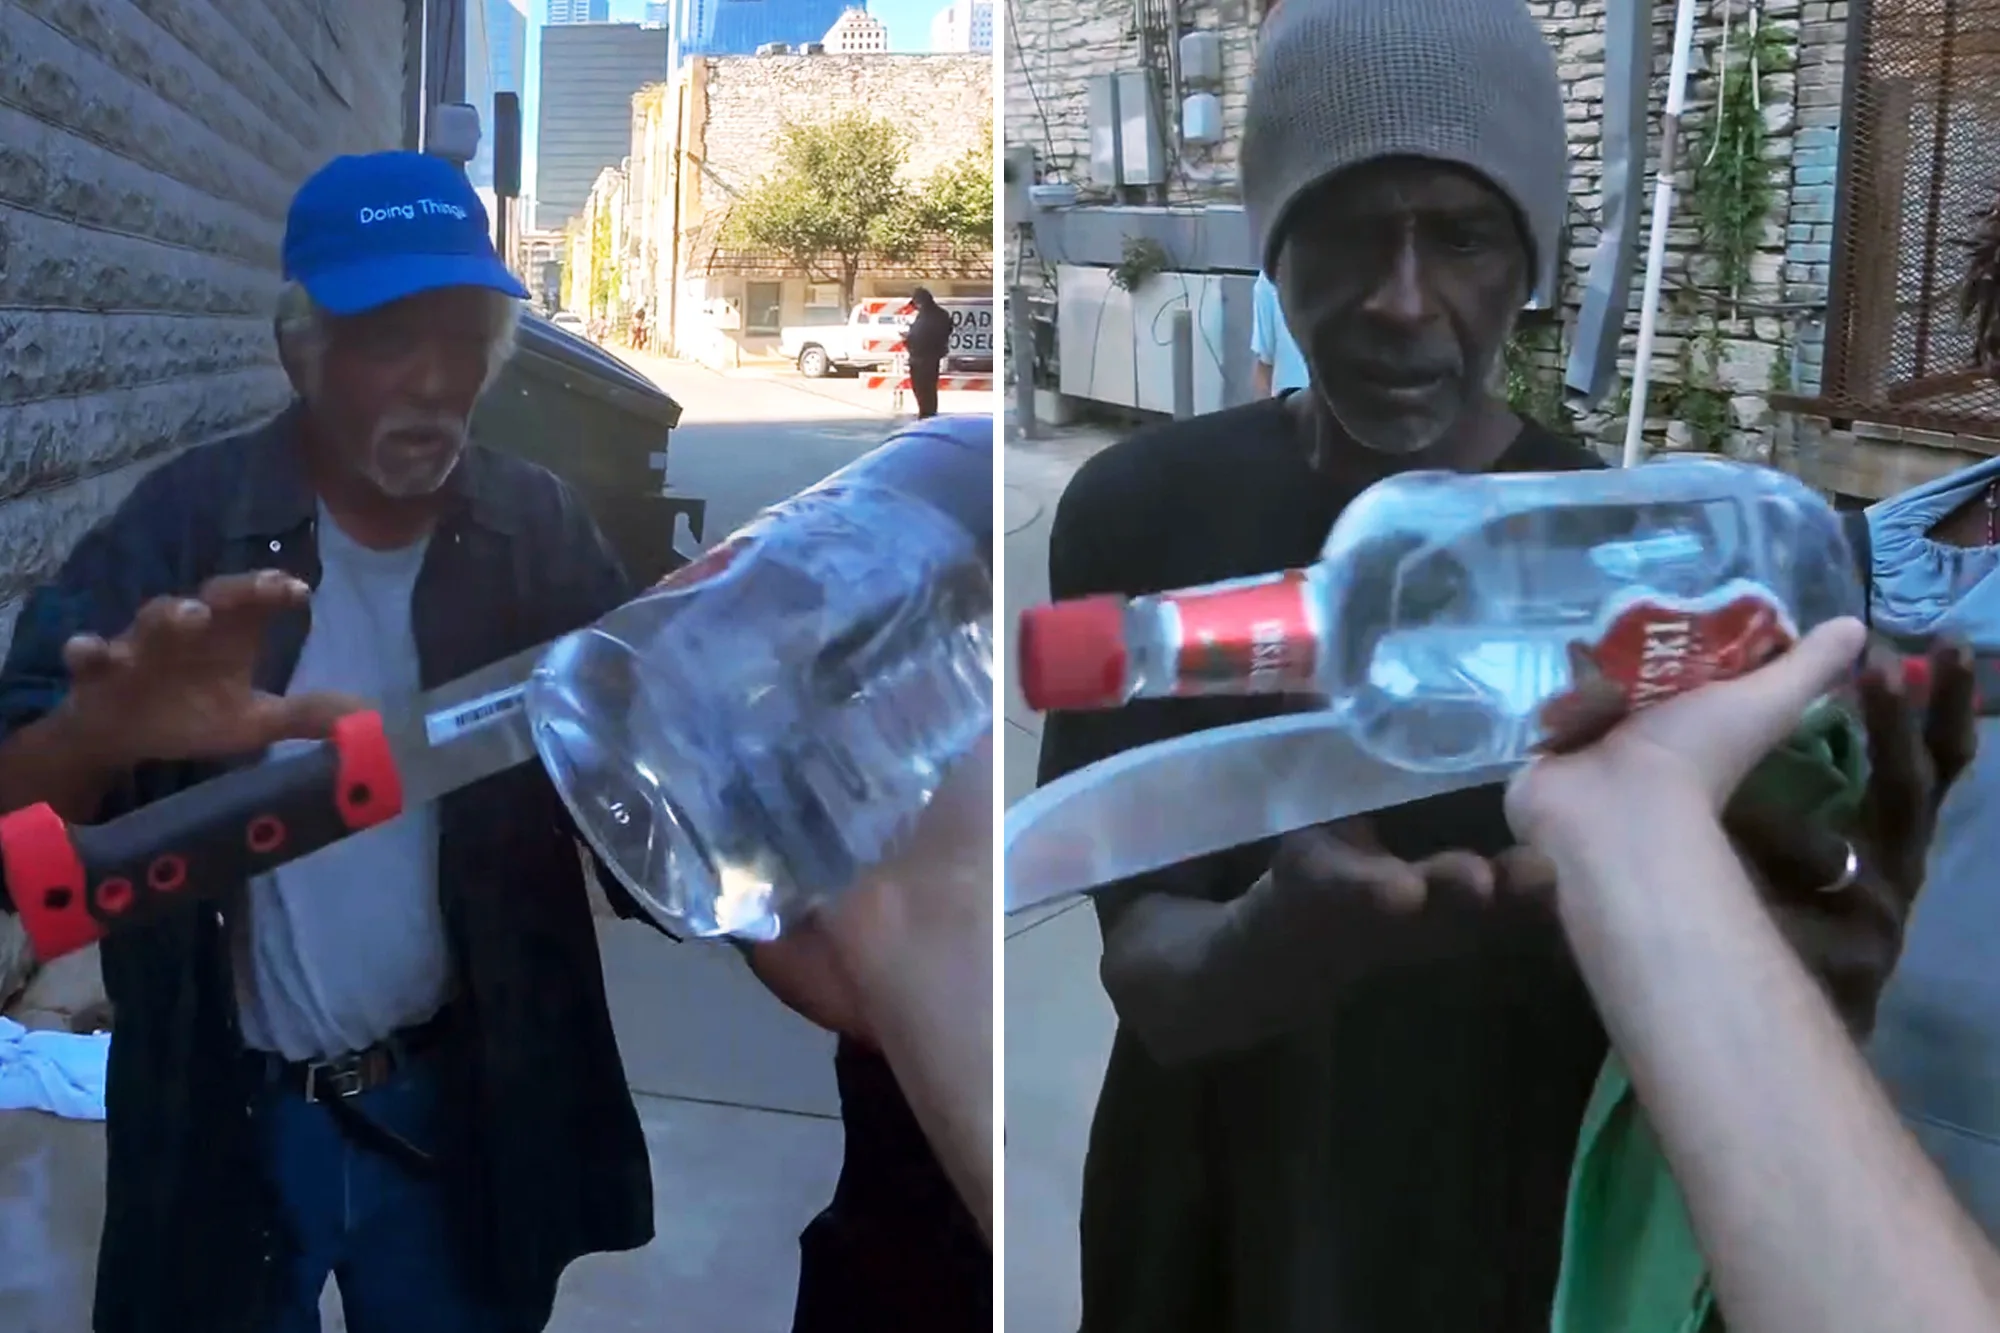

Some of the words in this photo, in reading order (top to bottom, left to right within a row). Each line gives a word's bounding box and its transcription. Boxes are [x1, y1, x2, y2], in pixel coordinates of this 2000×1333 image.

[360, 204, 415, 224] Doing
[951, 311, 992, 327] OAD
[950, 333, 993, 349] OSE
[1630, 621, 1690, 710] YSKI
